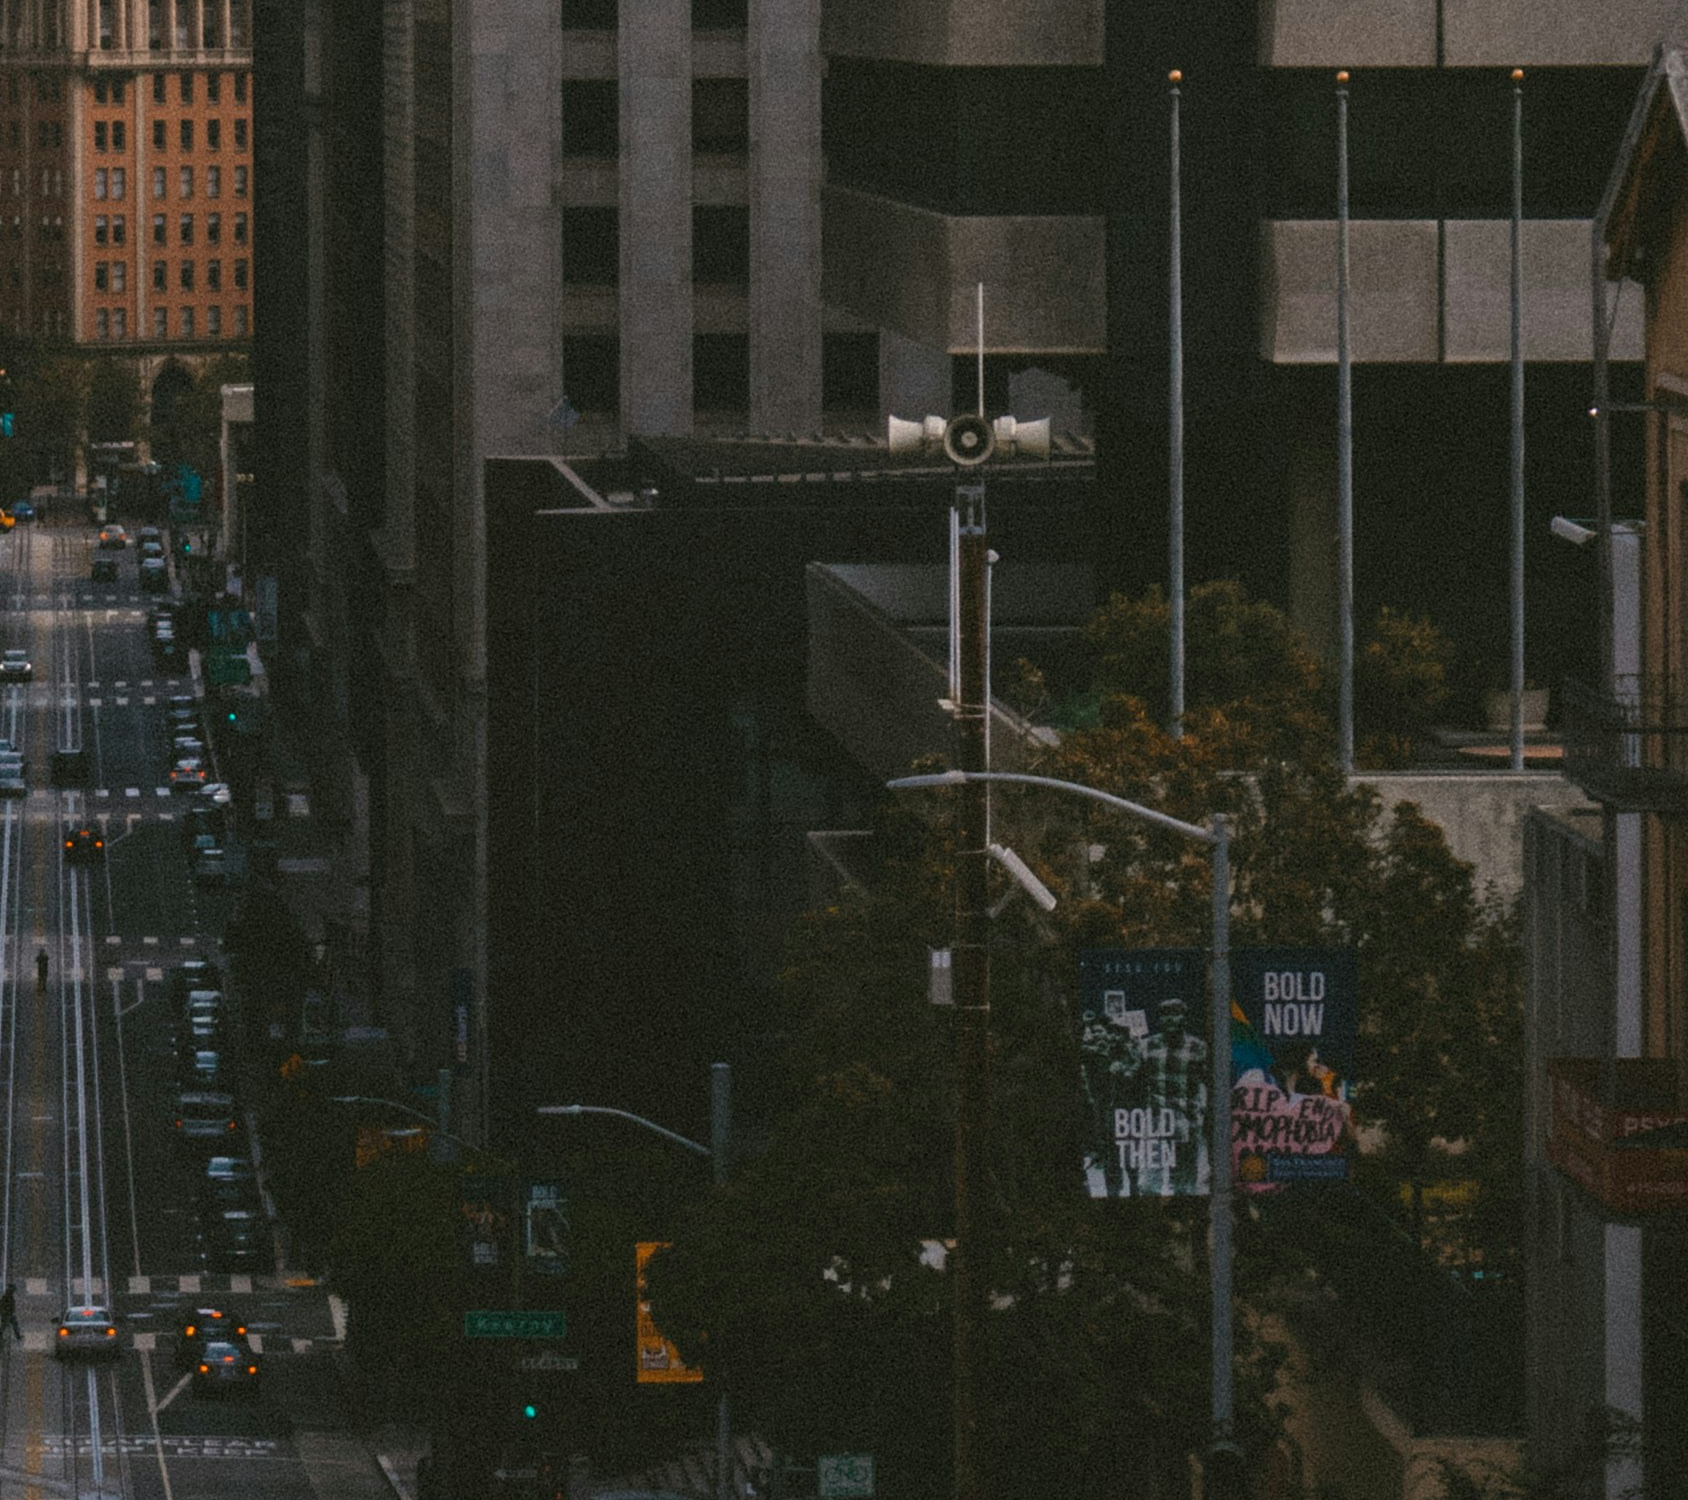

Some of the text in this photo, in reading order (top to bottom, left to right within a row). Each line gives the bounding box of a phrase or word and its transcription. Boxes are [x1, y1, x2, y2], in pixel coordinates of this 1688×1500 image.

[1263, 971, 1326, 1002] BOLD
[1263, 1003, 1325, 1036] NOW
[1113, 1107, 1176, 1139] BOLD
[1231, 1115, 1335, 1143] OMOPHOBIA
[1115, 1139, 1177, 1169] THEN
